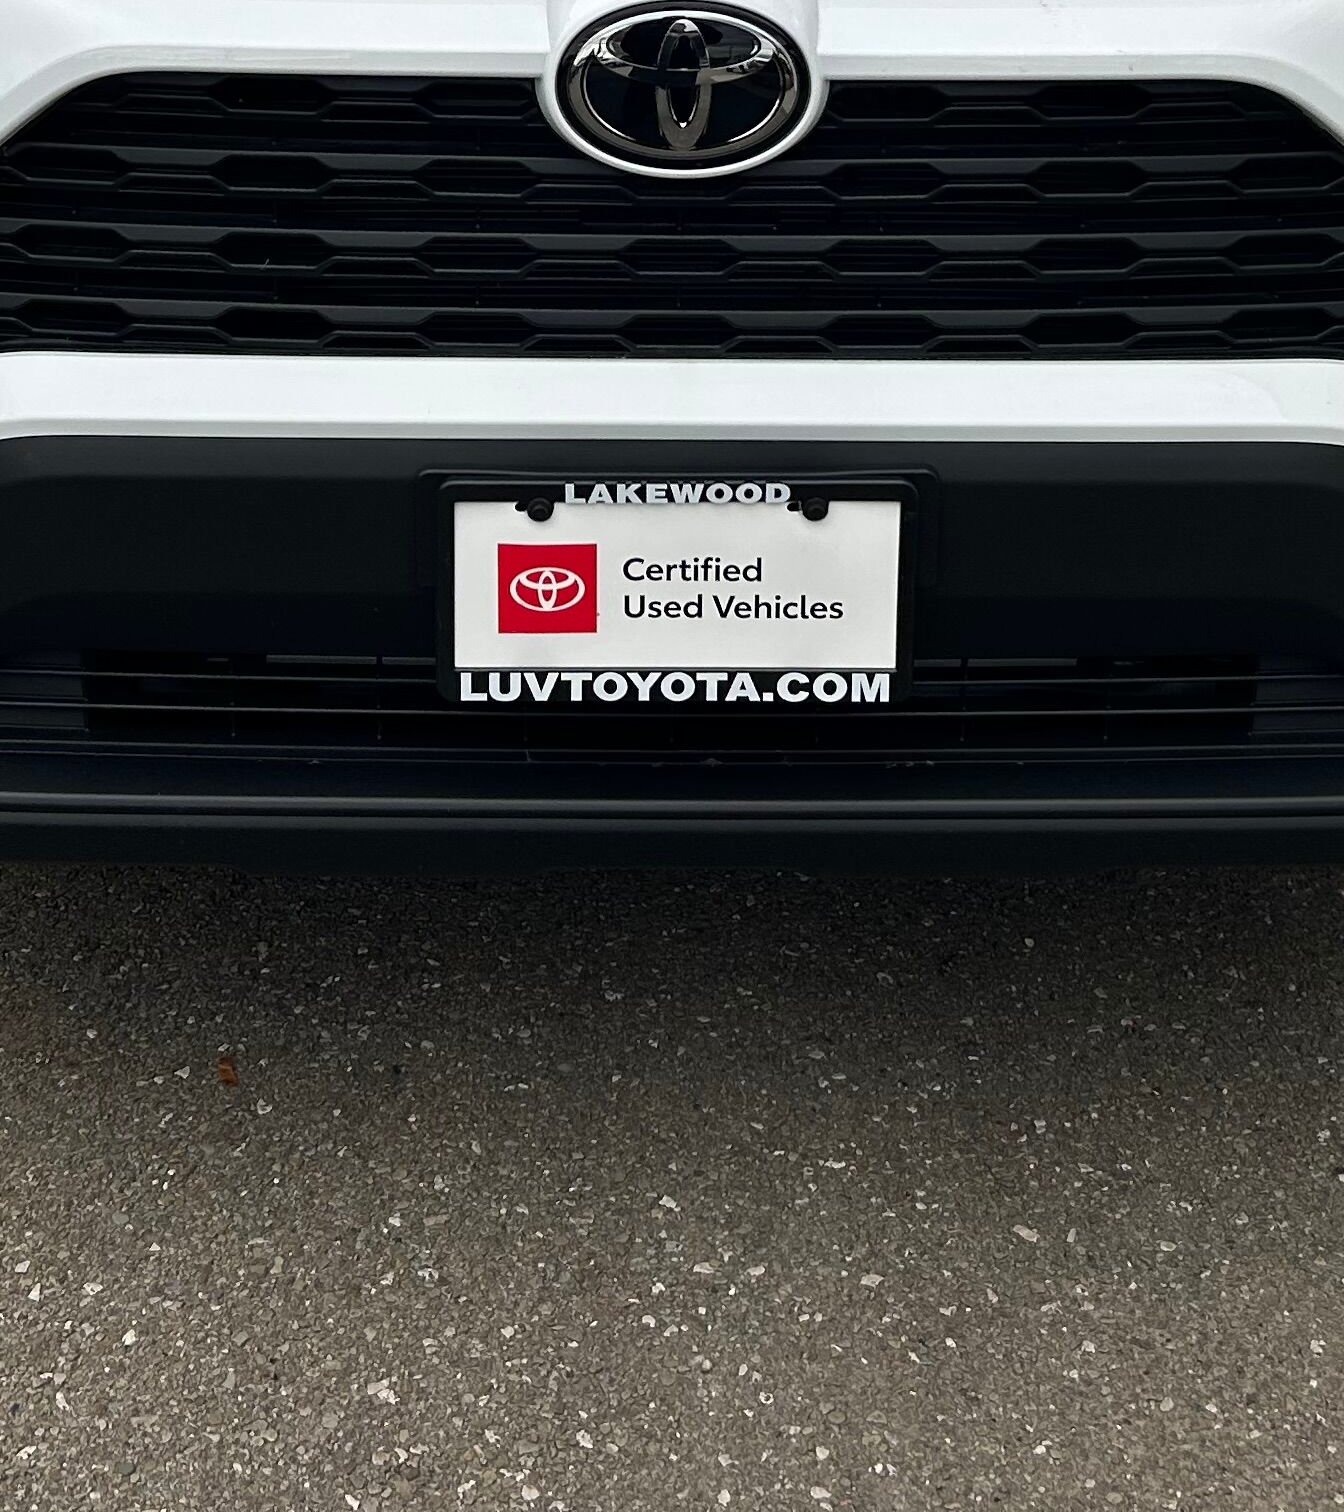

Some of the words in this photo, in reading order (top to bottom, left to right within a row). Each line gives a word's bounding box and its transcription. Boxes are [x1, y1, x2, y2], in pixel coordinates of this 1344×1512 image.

[564, 482, 792, 505] LAKEWOOD
[622, 557, 763, 582] Certified
[623, 594, 704, 619] Used
[713, 594, 844, 619] Vehicles
[460, 671, 891, 703] LUVTOYOTA.COM
